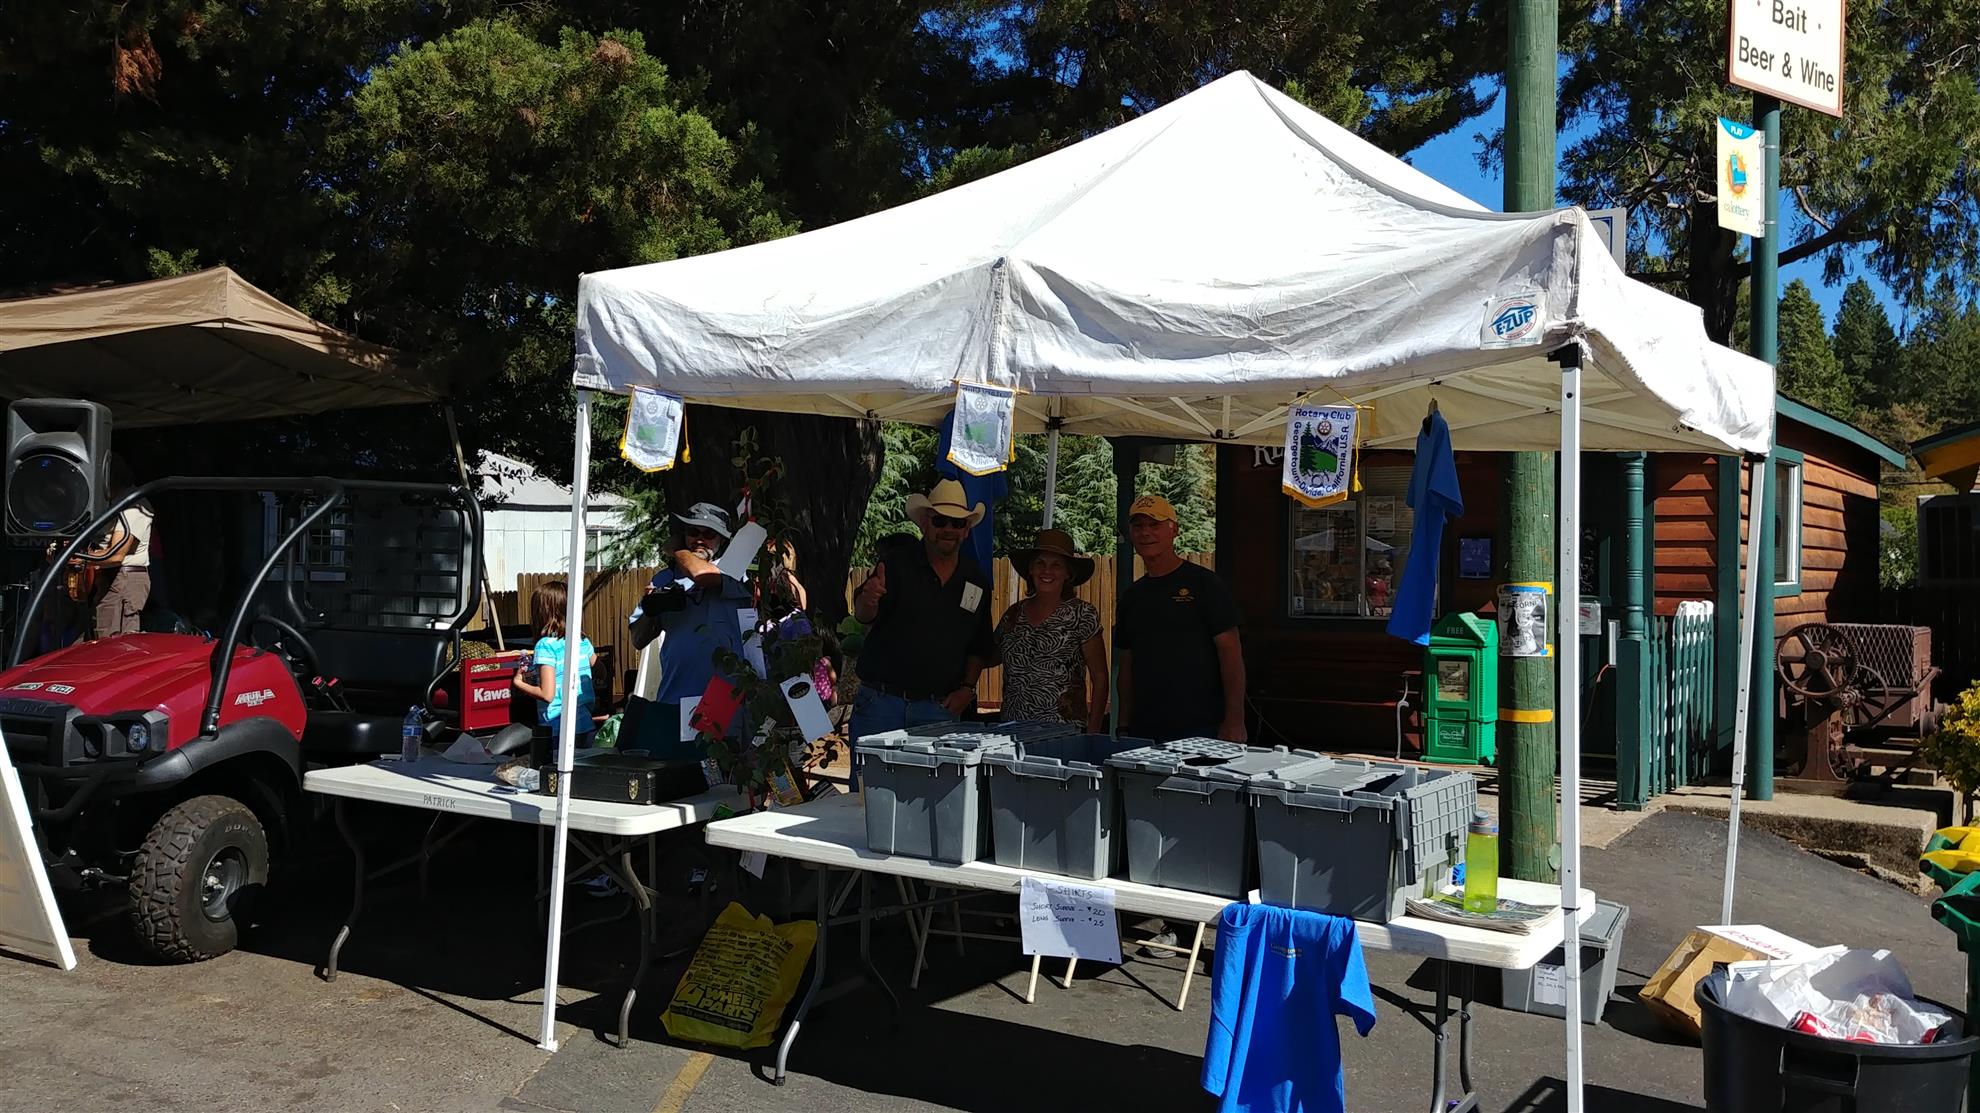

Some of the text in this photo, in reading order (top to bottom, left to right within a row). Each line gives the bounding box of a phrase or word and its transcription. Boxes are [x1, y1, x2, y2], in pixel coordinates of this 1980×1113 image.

[1772, 0, 1807, 34] Bait
[1739, 35, 1834, 93] Beer & Wine
[1295, 408, 1351, 421] Rotary Club
[1446, 626, 1464, 635] FREE
[473, 687, 511, 703] Kawa
[423, 794, 456, 809] PATRICK
[700, 998, 755, 1022] PARTS
